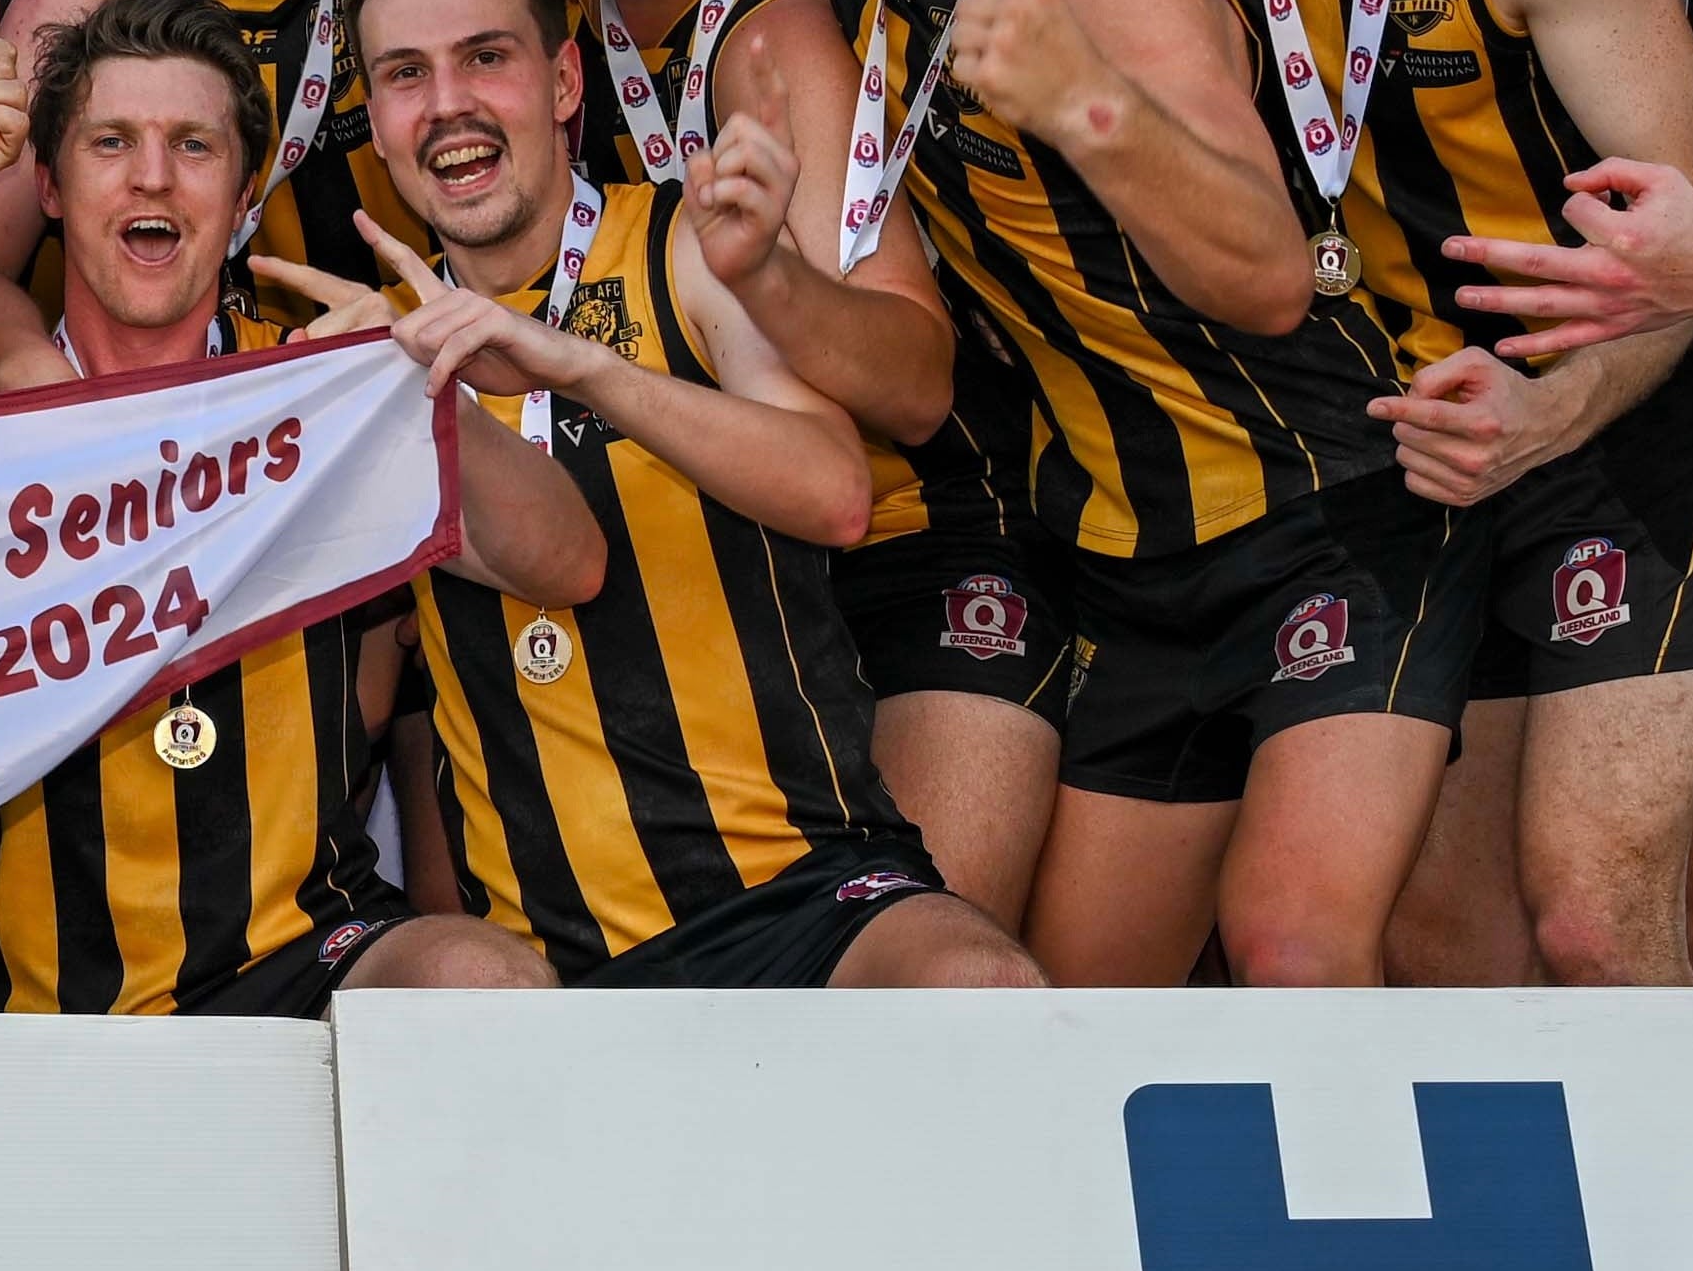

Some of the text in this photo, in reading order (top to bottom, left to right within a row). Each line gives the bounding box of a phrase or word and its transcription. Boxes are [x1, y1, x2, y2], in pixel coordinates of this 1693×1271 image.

[1412, 0, 1448, 13] YEARS
[1403, 52, 1472, 67] GARDNER
[1405, 66, 1476, 78] VAUGHAN
[597, 282, 620, 298] AFC
[4, 416, 302, 579] Seniors
[1568, 543, 1604, 565] AFL
[967, 581, 1007, 594] AFL
[1567, 569, 1609, 616] Q
[963, 595, 1007, 635] Q
[1558, 610, 1621, 637] QUEENSLAND
[949, 634, 1016, 651] QUEENSLAND
[1289, 620, 1332, 659] Q
[1281, 650, 1345, 677] QUEENSLAND
[162, 748, 206, 766] PREMIERS
